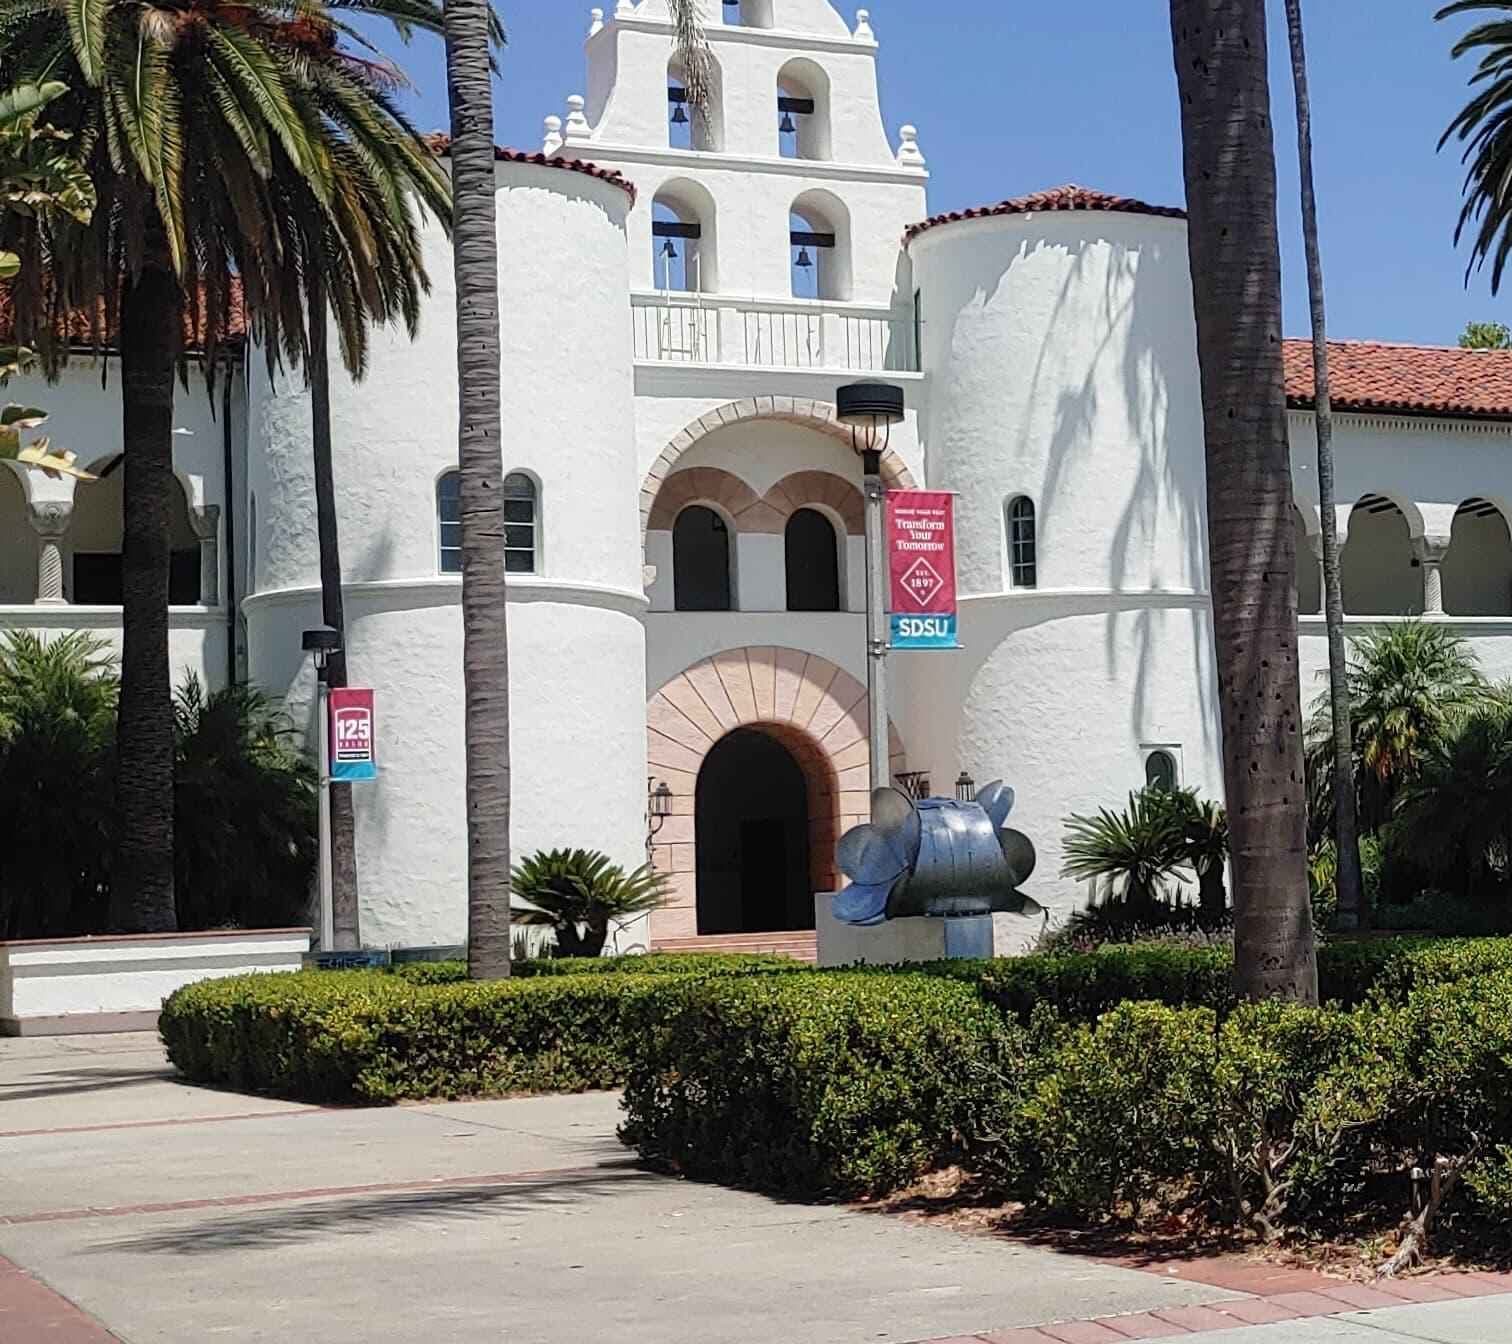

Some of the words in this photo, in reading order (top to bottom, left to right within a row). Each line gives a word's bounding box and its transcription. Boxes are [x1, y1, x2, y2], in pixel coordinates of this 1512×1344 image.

[895, 518, 945, 530] Transform
[909, 530, 932, 541] Your
[896, 540, 945, 551] Tomorrow
[911, 578, 934, 588] 1897
[900, 618, 949, 637] SDSU
[337, 719, 369, 740] 125
